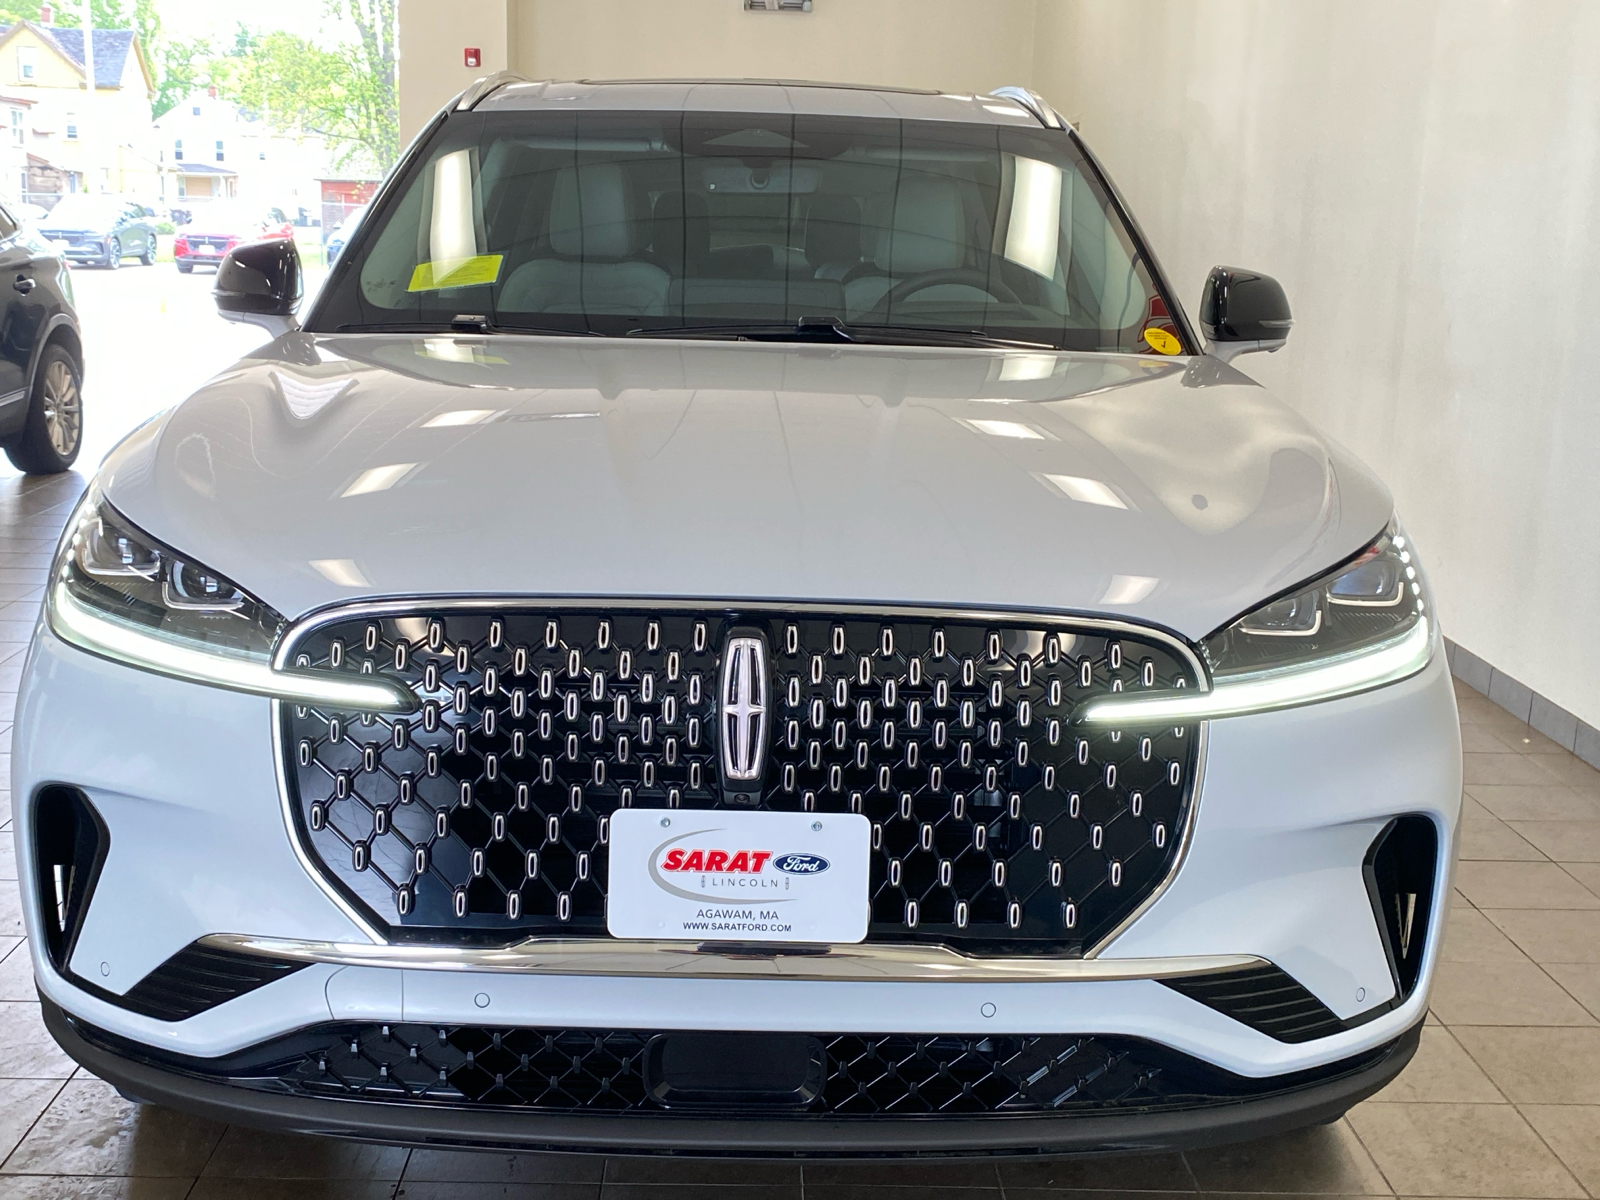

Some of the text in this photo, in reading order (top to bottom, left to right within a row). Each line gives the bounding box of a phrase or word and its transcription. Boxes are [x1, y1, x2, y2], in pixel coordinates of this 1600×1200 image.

[661, 848, 819, 874] SARAT Ford
[712, 877, 778, 888] LINCOLN
[696, 909, 779, 921] AGAWAM, MA
[682, 921, 792, 933] WWW.SARATFORD.COM
